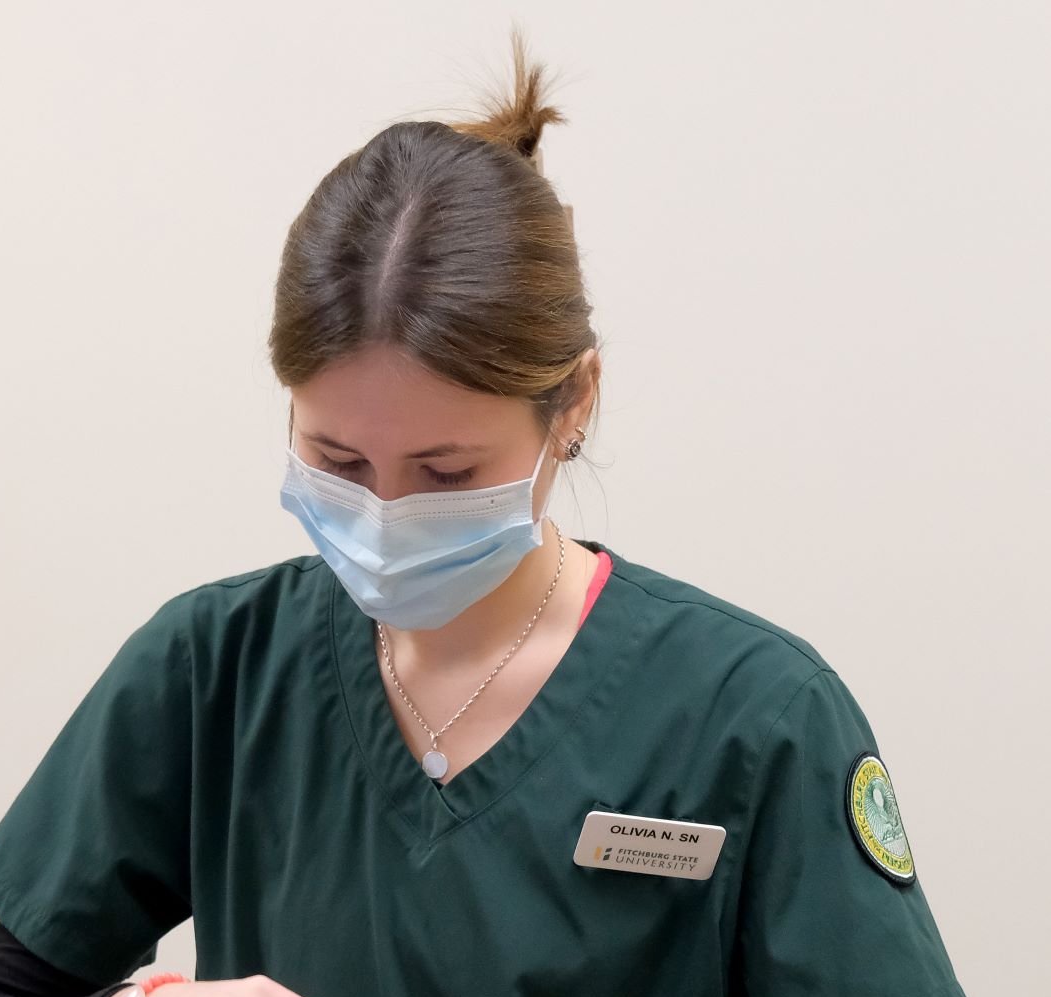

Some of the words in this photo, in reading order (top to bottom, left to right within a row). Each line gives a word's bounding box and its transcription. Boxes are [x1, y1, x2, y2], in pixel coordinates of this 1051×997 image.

[610, 825, 657, 839] OLIVIA
[661, 831, 674, 841] N.
[679, 833, 700, 844] SN
[615, 856, 697, 872] UNIVERSITY
[618, 848, 670, 860] FITCHBURG
[672, 855, 699, 864] STATE
